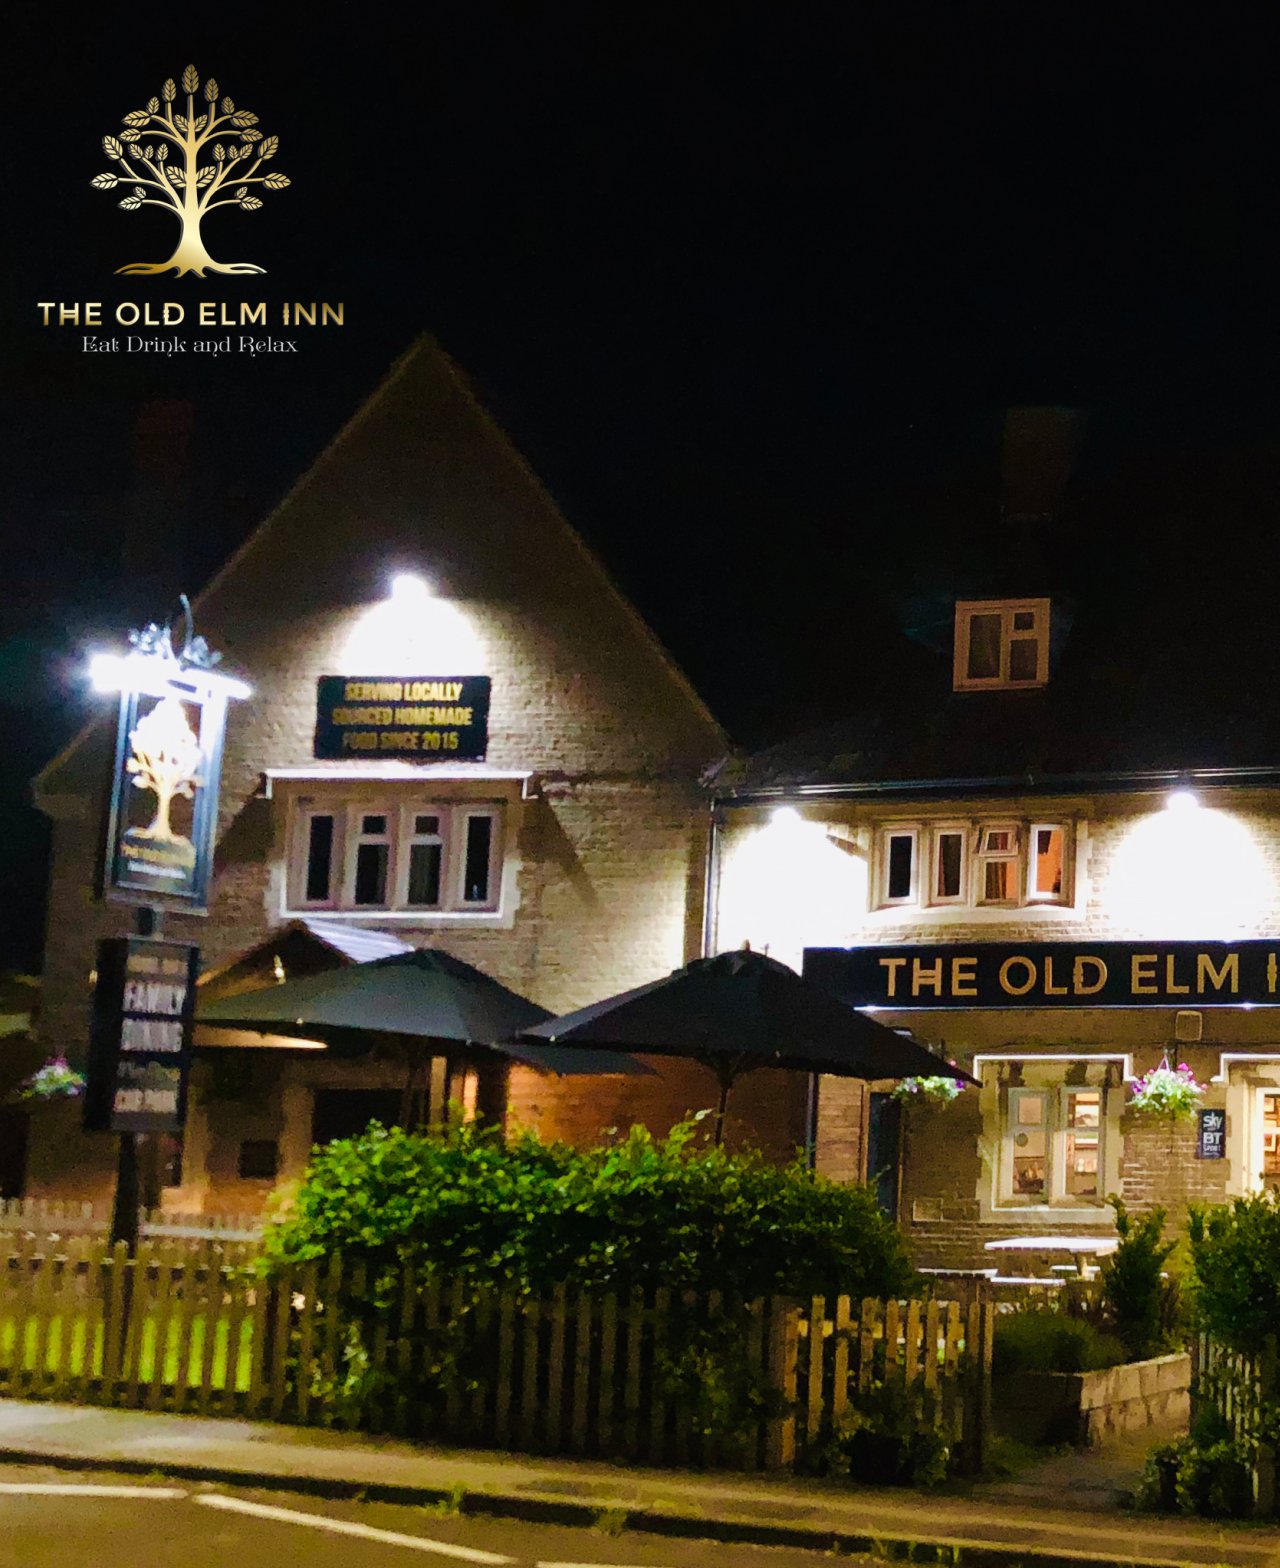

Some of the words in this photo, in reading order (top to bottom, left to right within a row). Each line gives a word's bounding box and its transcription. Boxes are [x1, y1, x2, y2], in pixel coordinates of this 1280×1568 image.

[344, 681, 402, 702] SERVING
[404, 681, 463, 702] LOCALLY
[394, 706, 473, 727] HOMEMADE
[422, 731, 459, 750] 2015
[879, 957, 978, 998] THE
[999, 955, 1108, 996] OLD
[1131, 953, 1239, 995] ELM
[1203, 1111, 1223, 1130] sky
[1203, 1132, 1223, 1144] BT
